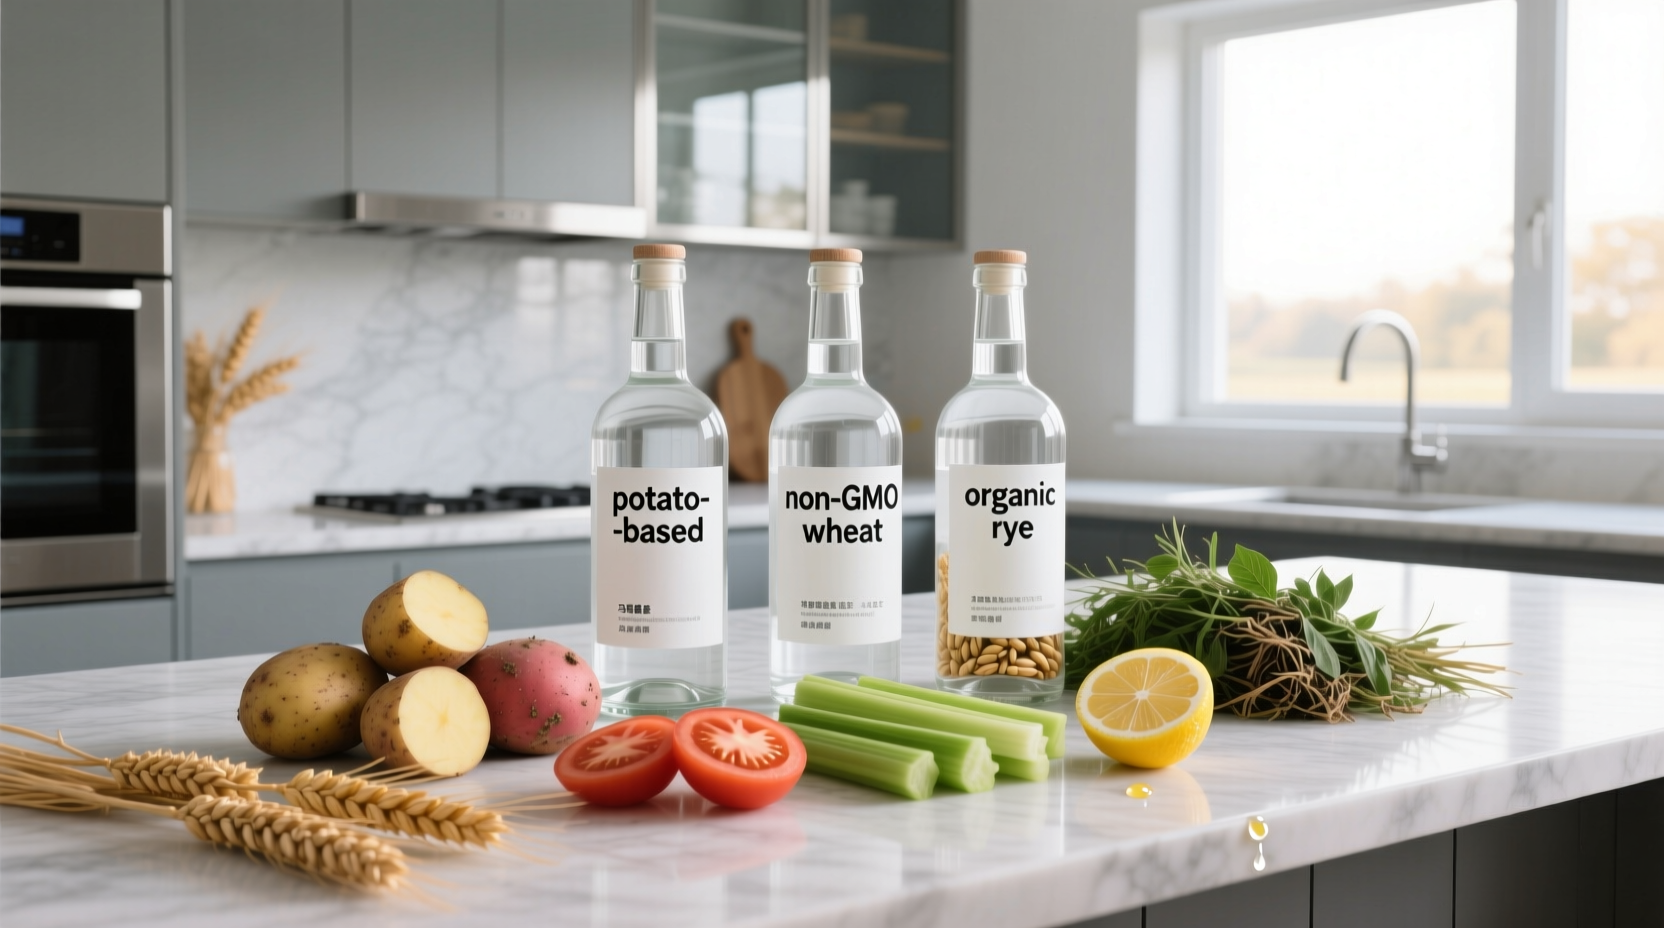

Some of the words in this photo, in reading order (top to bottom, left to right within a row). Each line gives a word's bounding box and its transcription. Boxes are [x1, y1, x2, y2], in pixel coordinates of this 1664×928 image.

[613, 486, 710, 516] potato-
[785, 484, 898, 511] non-GMO
[965, 481, 1056, 514] organic
[613, 516, 704, 544] -based
[803, 517, 883, 544] wheat
[992, 519, 1034, 546] rye
